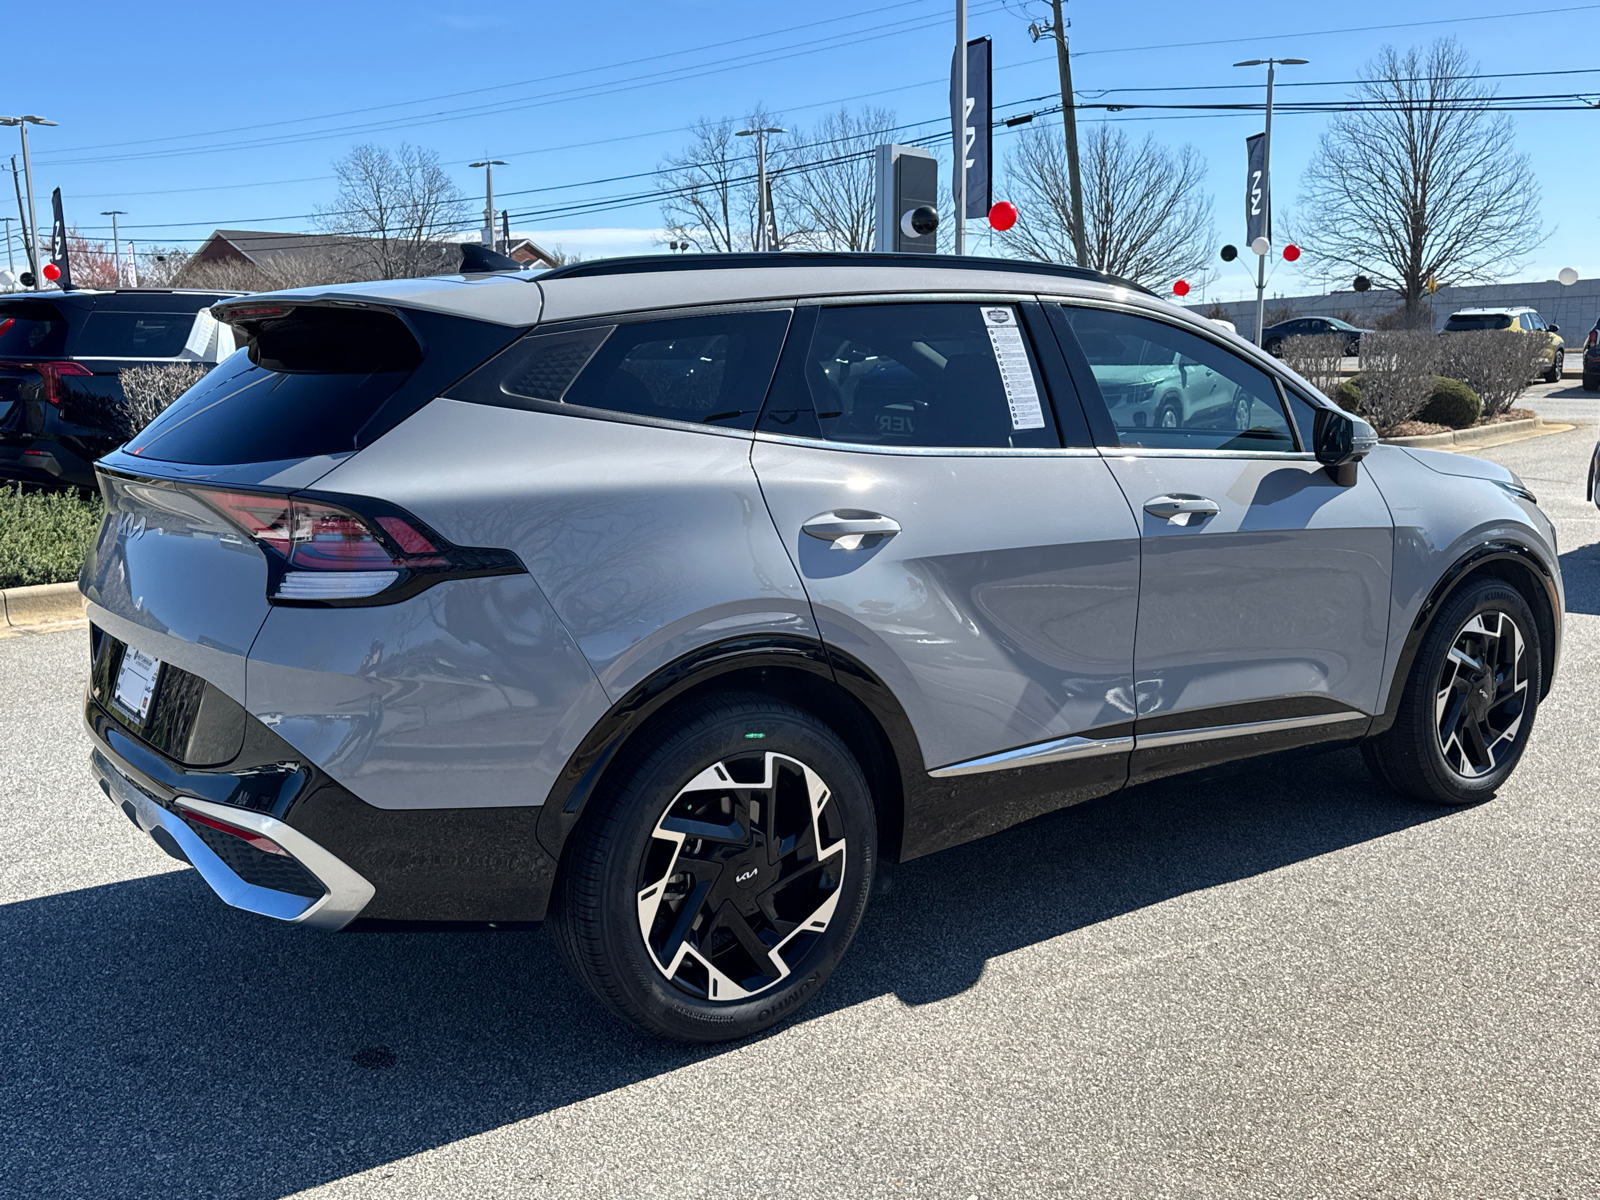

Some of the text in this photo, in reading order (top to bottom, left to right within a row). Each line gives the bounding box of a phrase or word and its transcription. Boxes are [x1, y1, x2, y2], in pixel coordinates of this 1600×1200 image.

[116, 510, 147, 540] KIA
[1484, 591, 1515, 604] KUMHO
[735, 867, 758, 883] KIA
[757, 970, 822, 1022] KUMHO
